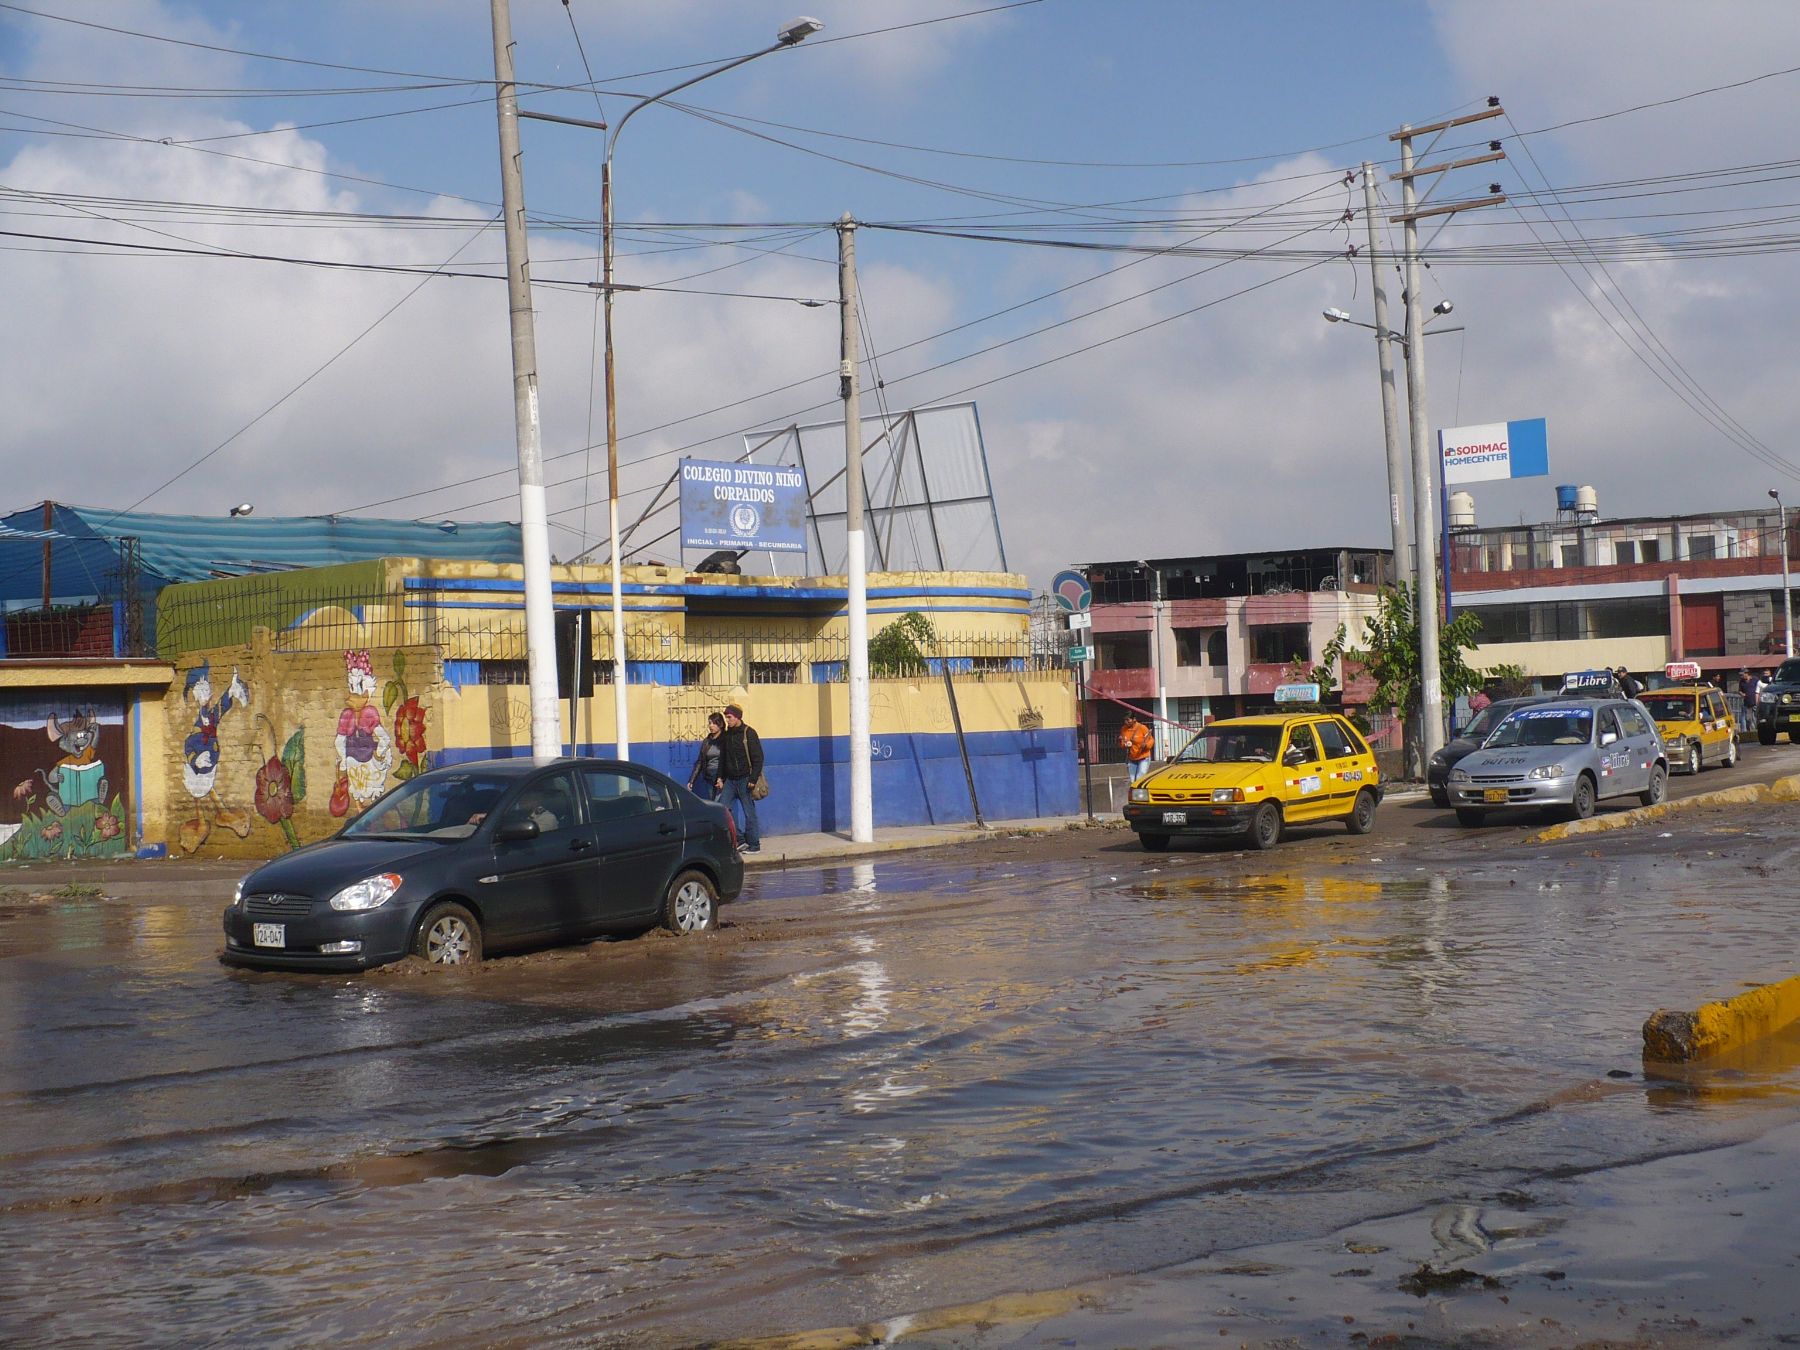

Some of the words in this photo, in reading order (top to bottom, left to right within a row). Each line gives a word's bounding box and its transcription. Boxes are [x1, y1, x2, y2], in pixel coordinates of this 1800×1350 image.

[1456, 442, 1507, 456] SODIMAC
[1445, 452, 1508, 466] HOMECENTER
[683, 465, 732, 483] COLEGIO
[735, 469, 773, 486] DIVINO
[776, 469, 802, 488] NIÑO
[714, 485, 775, 504] CORPAIDOS
[687, 538, 714, 546] INICIAL
[758, 541, 802, 549] SECUNDARIA
[1578, 675, 1608, 687] Libre
